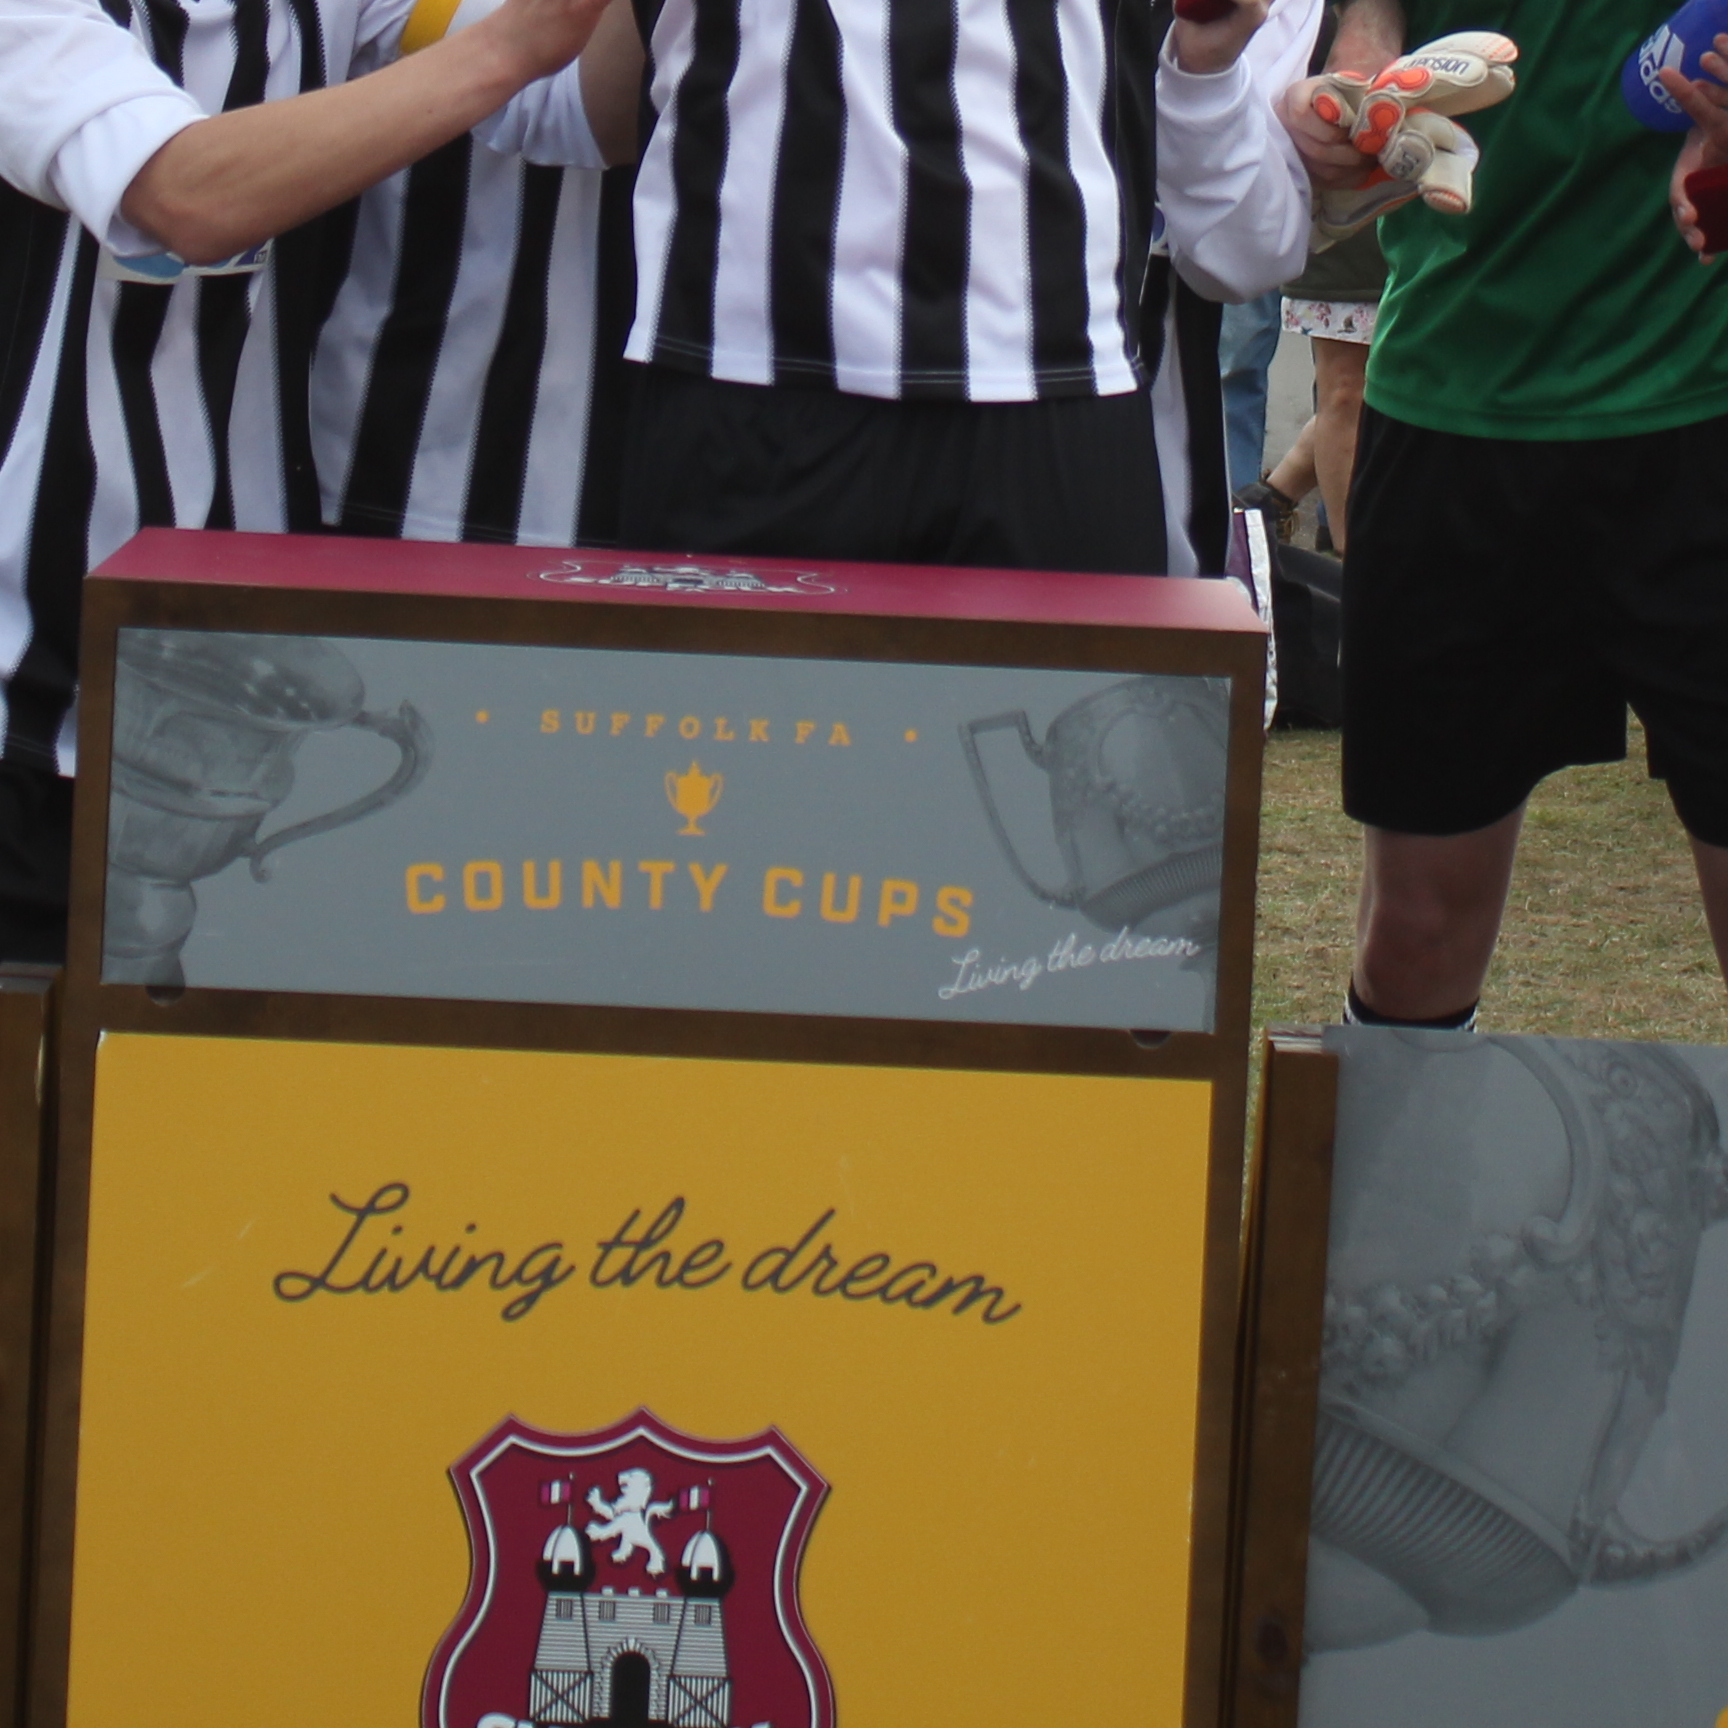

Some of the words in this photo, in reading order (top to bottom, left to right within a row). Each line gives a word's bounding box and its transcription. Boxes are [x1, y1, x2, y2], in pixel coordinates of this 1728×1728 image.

[540, 708, 771, 743] SUFFOLK
[794, 720, 853, 747] FA
[405, 859, 729, 914] COUNTY
[762, 866, 975, 937] CUPS
[938, 948, 1043, 1000] Living
[1046, 932, 1096, 972] the
[1099, 925, 1202, 963] dream
[272, 1182, 576, 1324] Living
[588, 1196, 732, 1291] the
[740, 1208, 1022, 1326] dream
